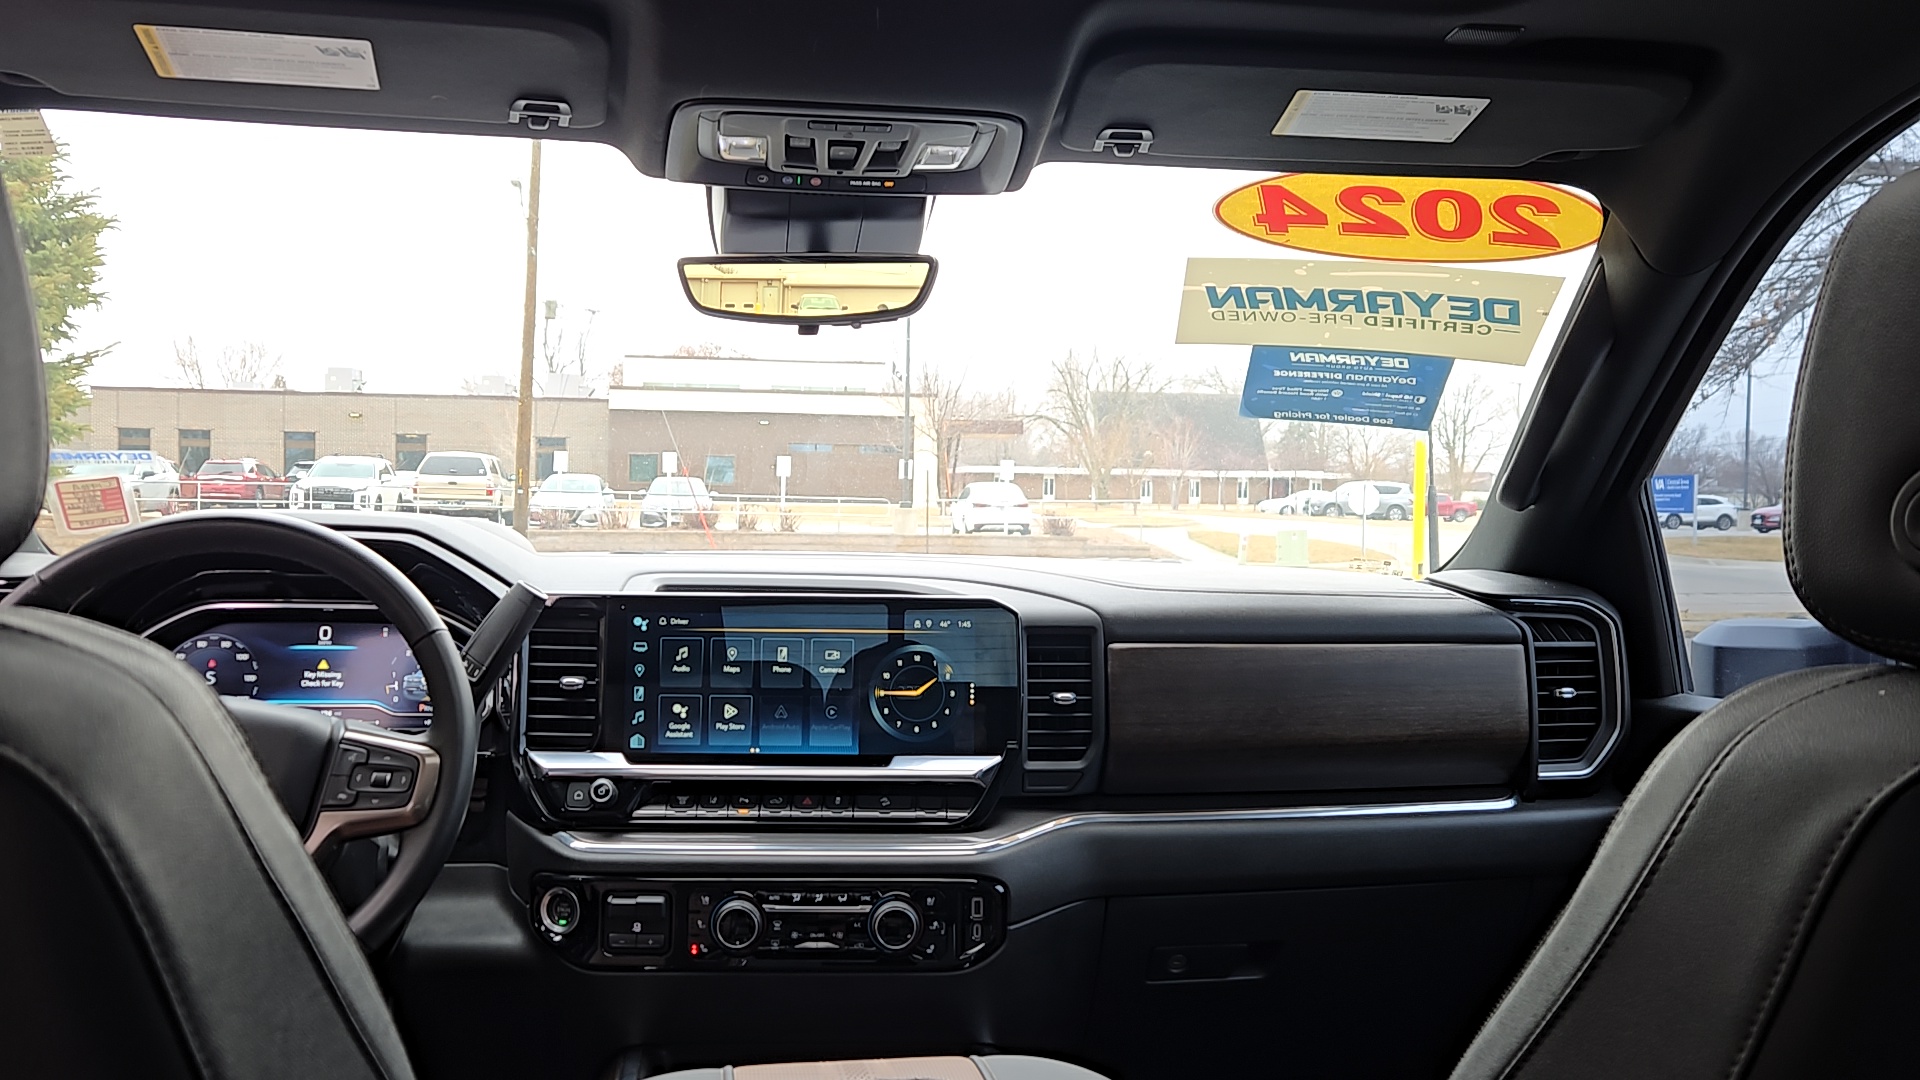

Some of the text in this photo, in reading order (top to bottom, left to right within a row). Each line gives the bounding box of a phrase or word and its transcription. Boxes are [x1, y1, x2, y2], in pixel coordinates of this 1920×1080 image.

[670, 617, 690, 626] Driver
[939, 620, 972, 629] 46° 1:45
[318, 625, 333, 641] 0
[672, 665, 691, 673] Audio
[723, 665, 741, 675] Maps
[772, 666, 792, 674] Phone
[819, 666, 846, 674] Cameras
[205, 670, 217, 685] S
[303, 670, 342, 680] Key Missing
[301, 680, 344, 689] Check for Key
[668, 722, 691, 731] Google
[715, 722, 746, 732] Play Store
